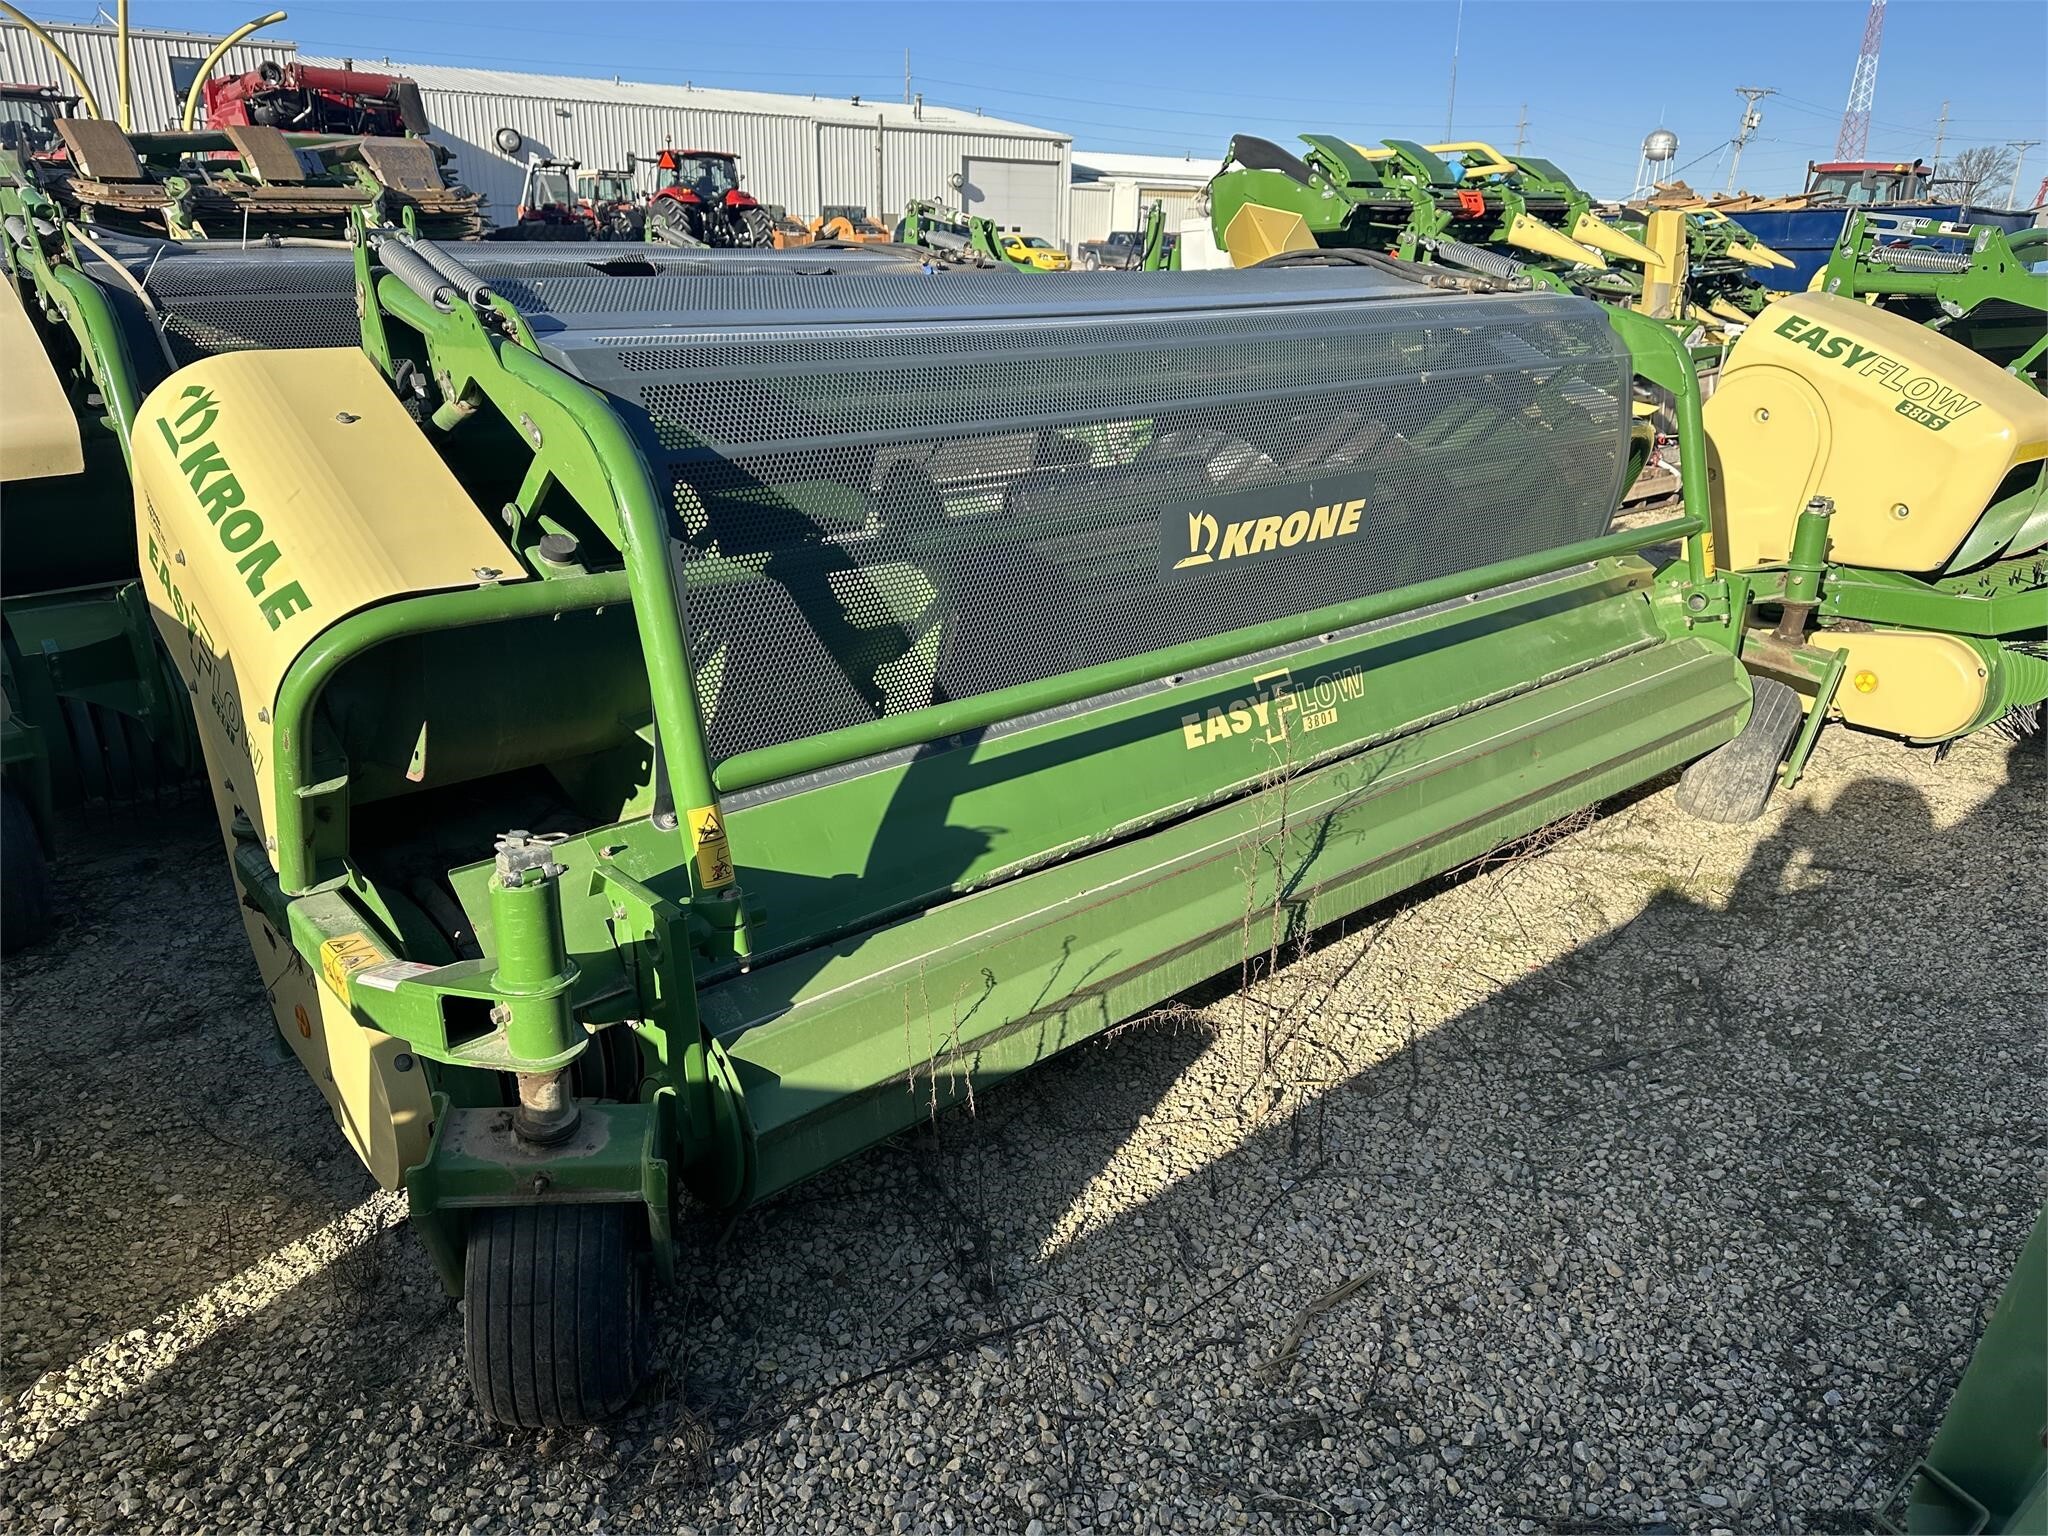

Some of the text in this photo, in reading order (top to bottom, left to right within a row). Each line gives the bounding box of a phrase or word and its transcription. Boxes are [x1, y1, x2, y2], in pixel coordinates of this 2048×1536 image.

[1899, 402, 1931, 422] 380
[180, 440, 313, 632] KRONE
[1218, 498, 1366, 560] KRONE
[1306, 709, 1334, 730] 3801
